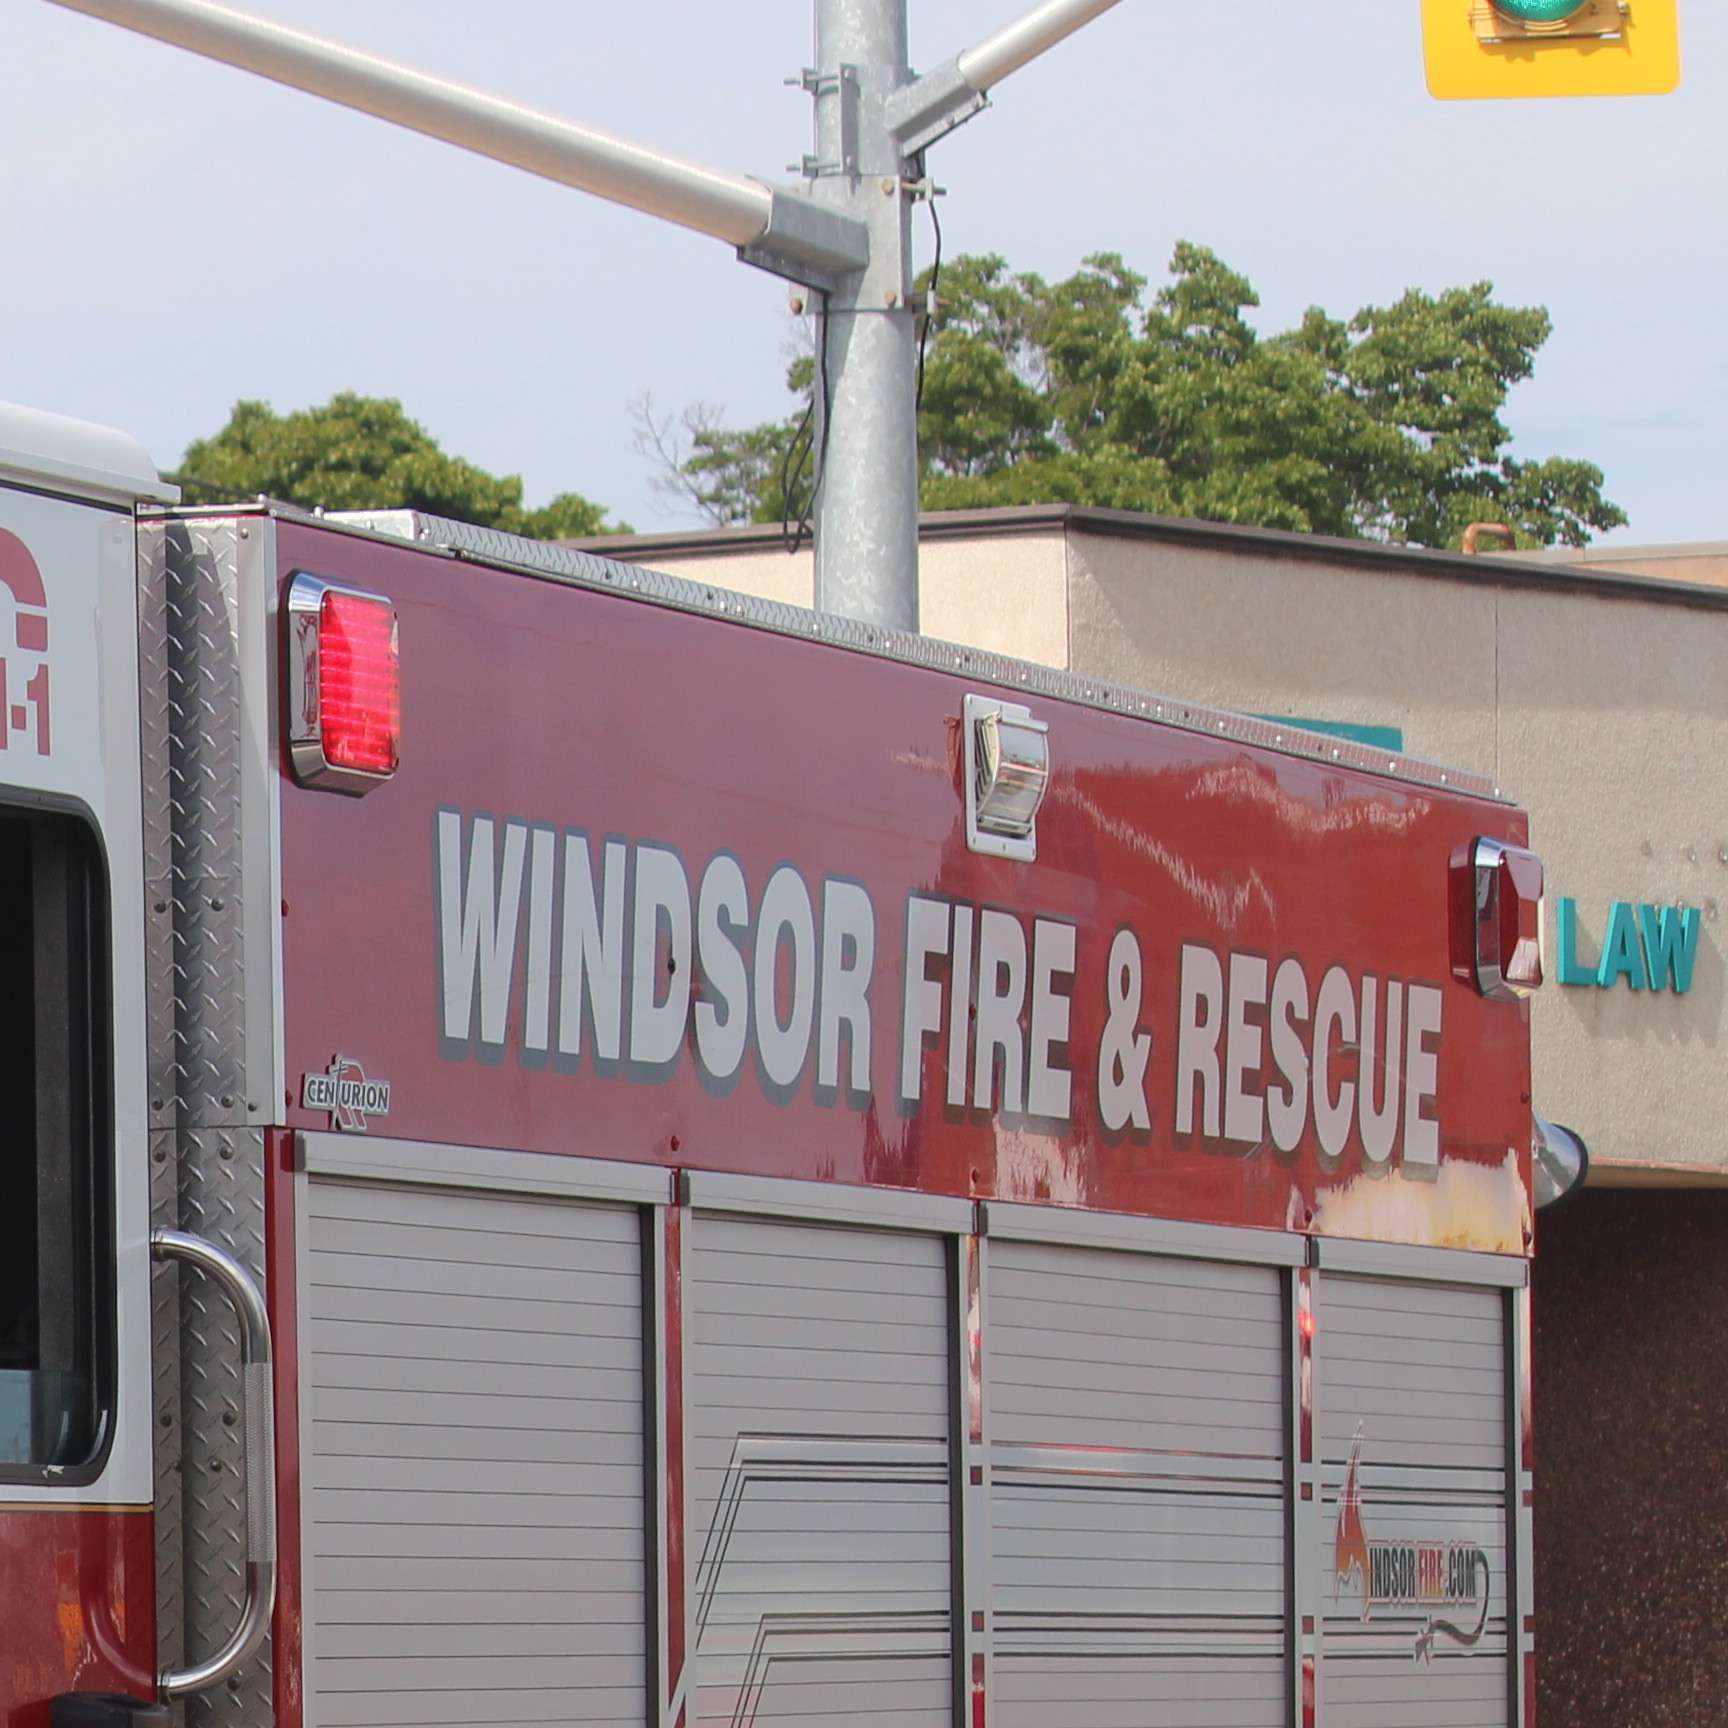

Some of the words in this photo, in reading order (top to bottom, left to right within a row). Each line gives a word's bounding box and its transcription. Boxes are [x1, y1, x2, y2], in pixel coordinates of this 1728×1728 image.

[435, 808, 876, 1108] WINDSOR
[898, 896, 1077, 1120] FIRE
[1097, 928, 1151, 1132] &
[1174, 942, 1444, 1176] RESCUE
[1555, 895, 1702, 994] LAW
